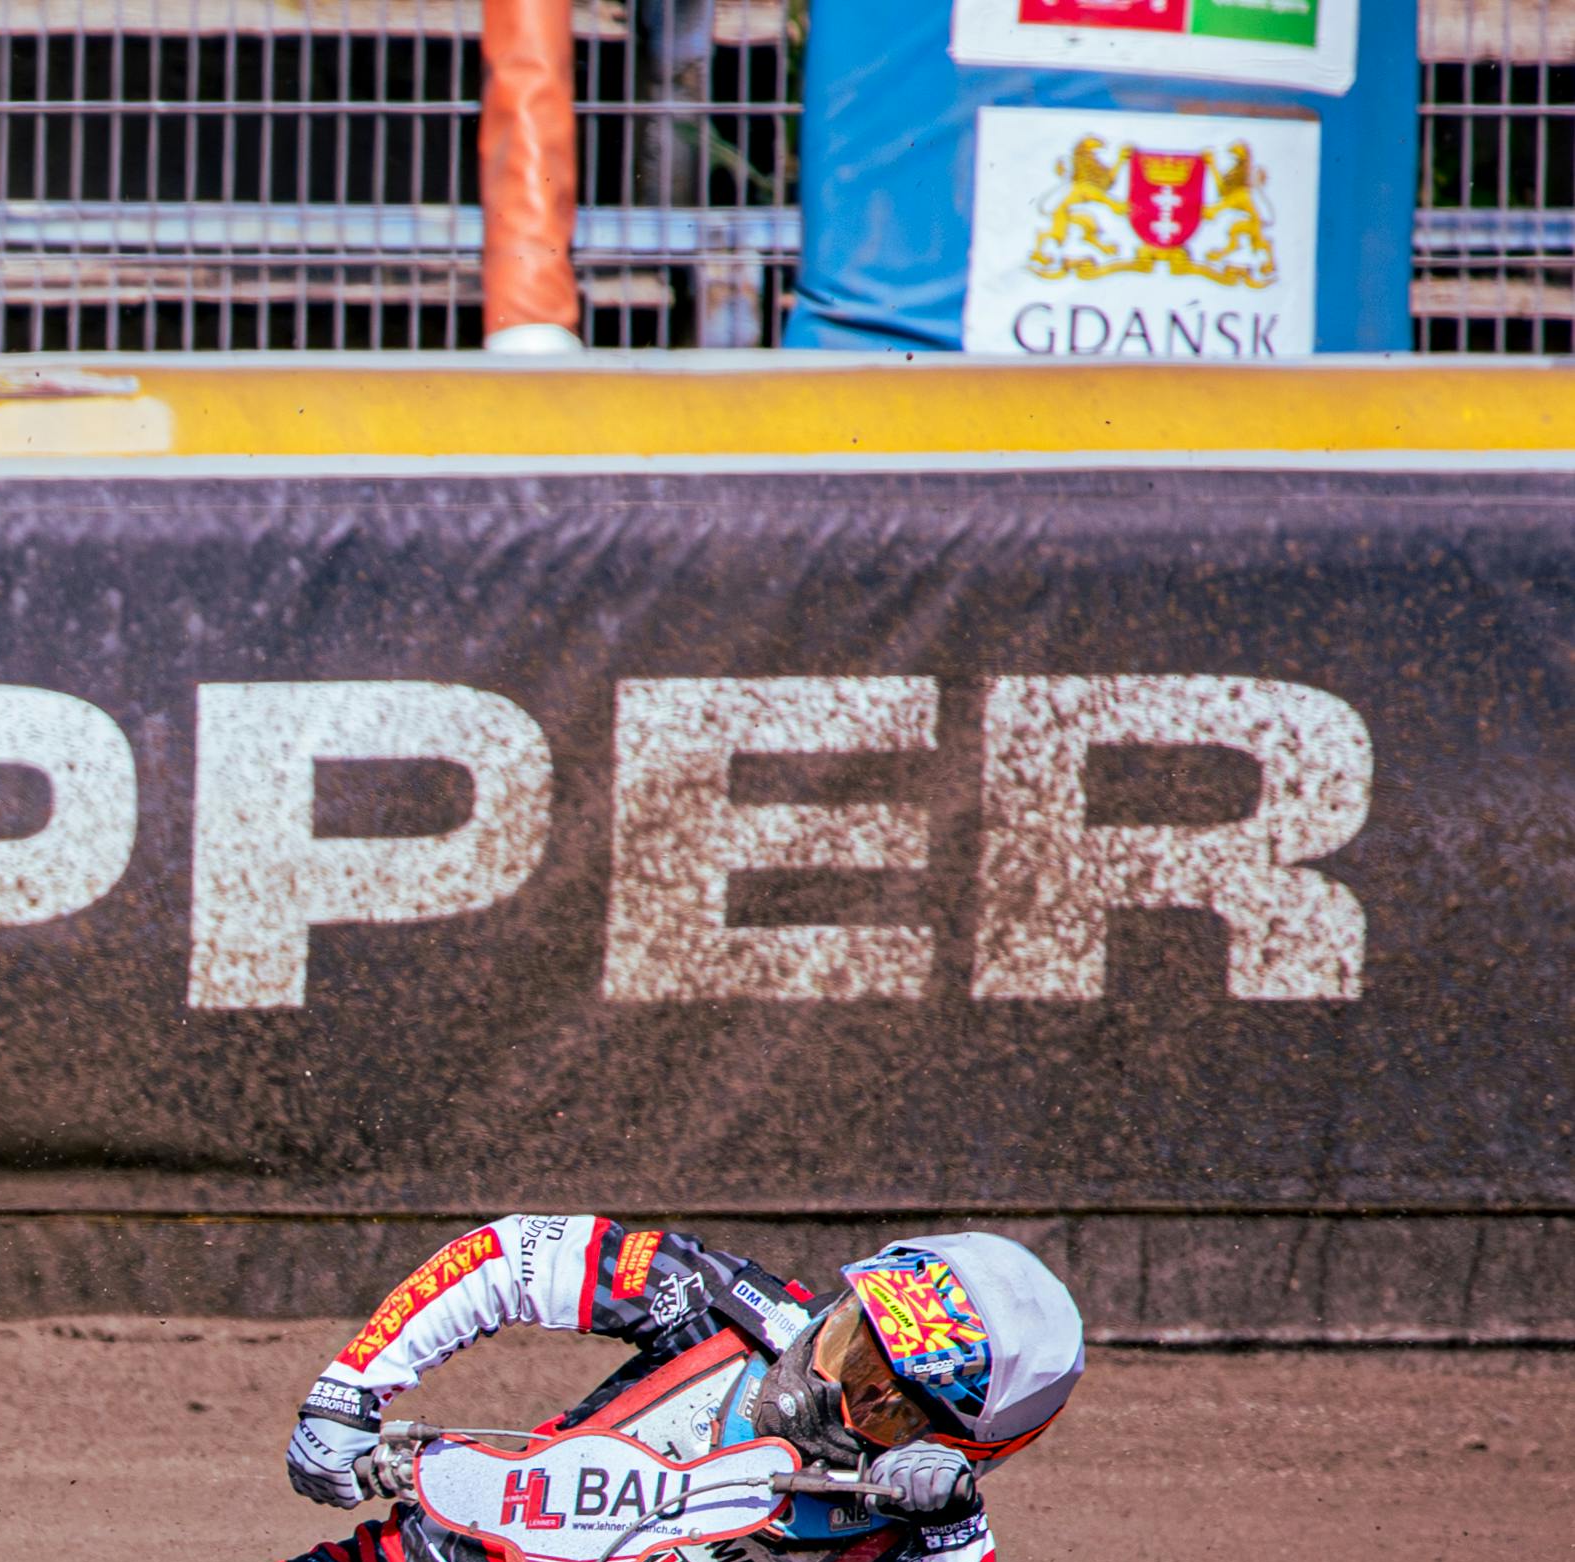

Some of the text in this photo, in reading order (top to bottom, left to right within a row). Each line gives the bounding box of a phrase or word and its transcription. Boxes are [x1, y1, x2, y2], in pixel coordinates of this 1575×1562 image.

[1013, 302, 1280, 356] GDAŃSK
[735, 1283, 763, 1307] DM
[313, 1381, 362, 1404] ESER
[307, 1396, 361, 1416] ESSOREN
[574, 1467, 691, 1520] BAU
